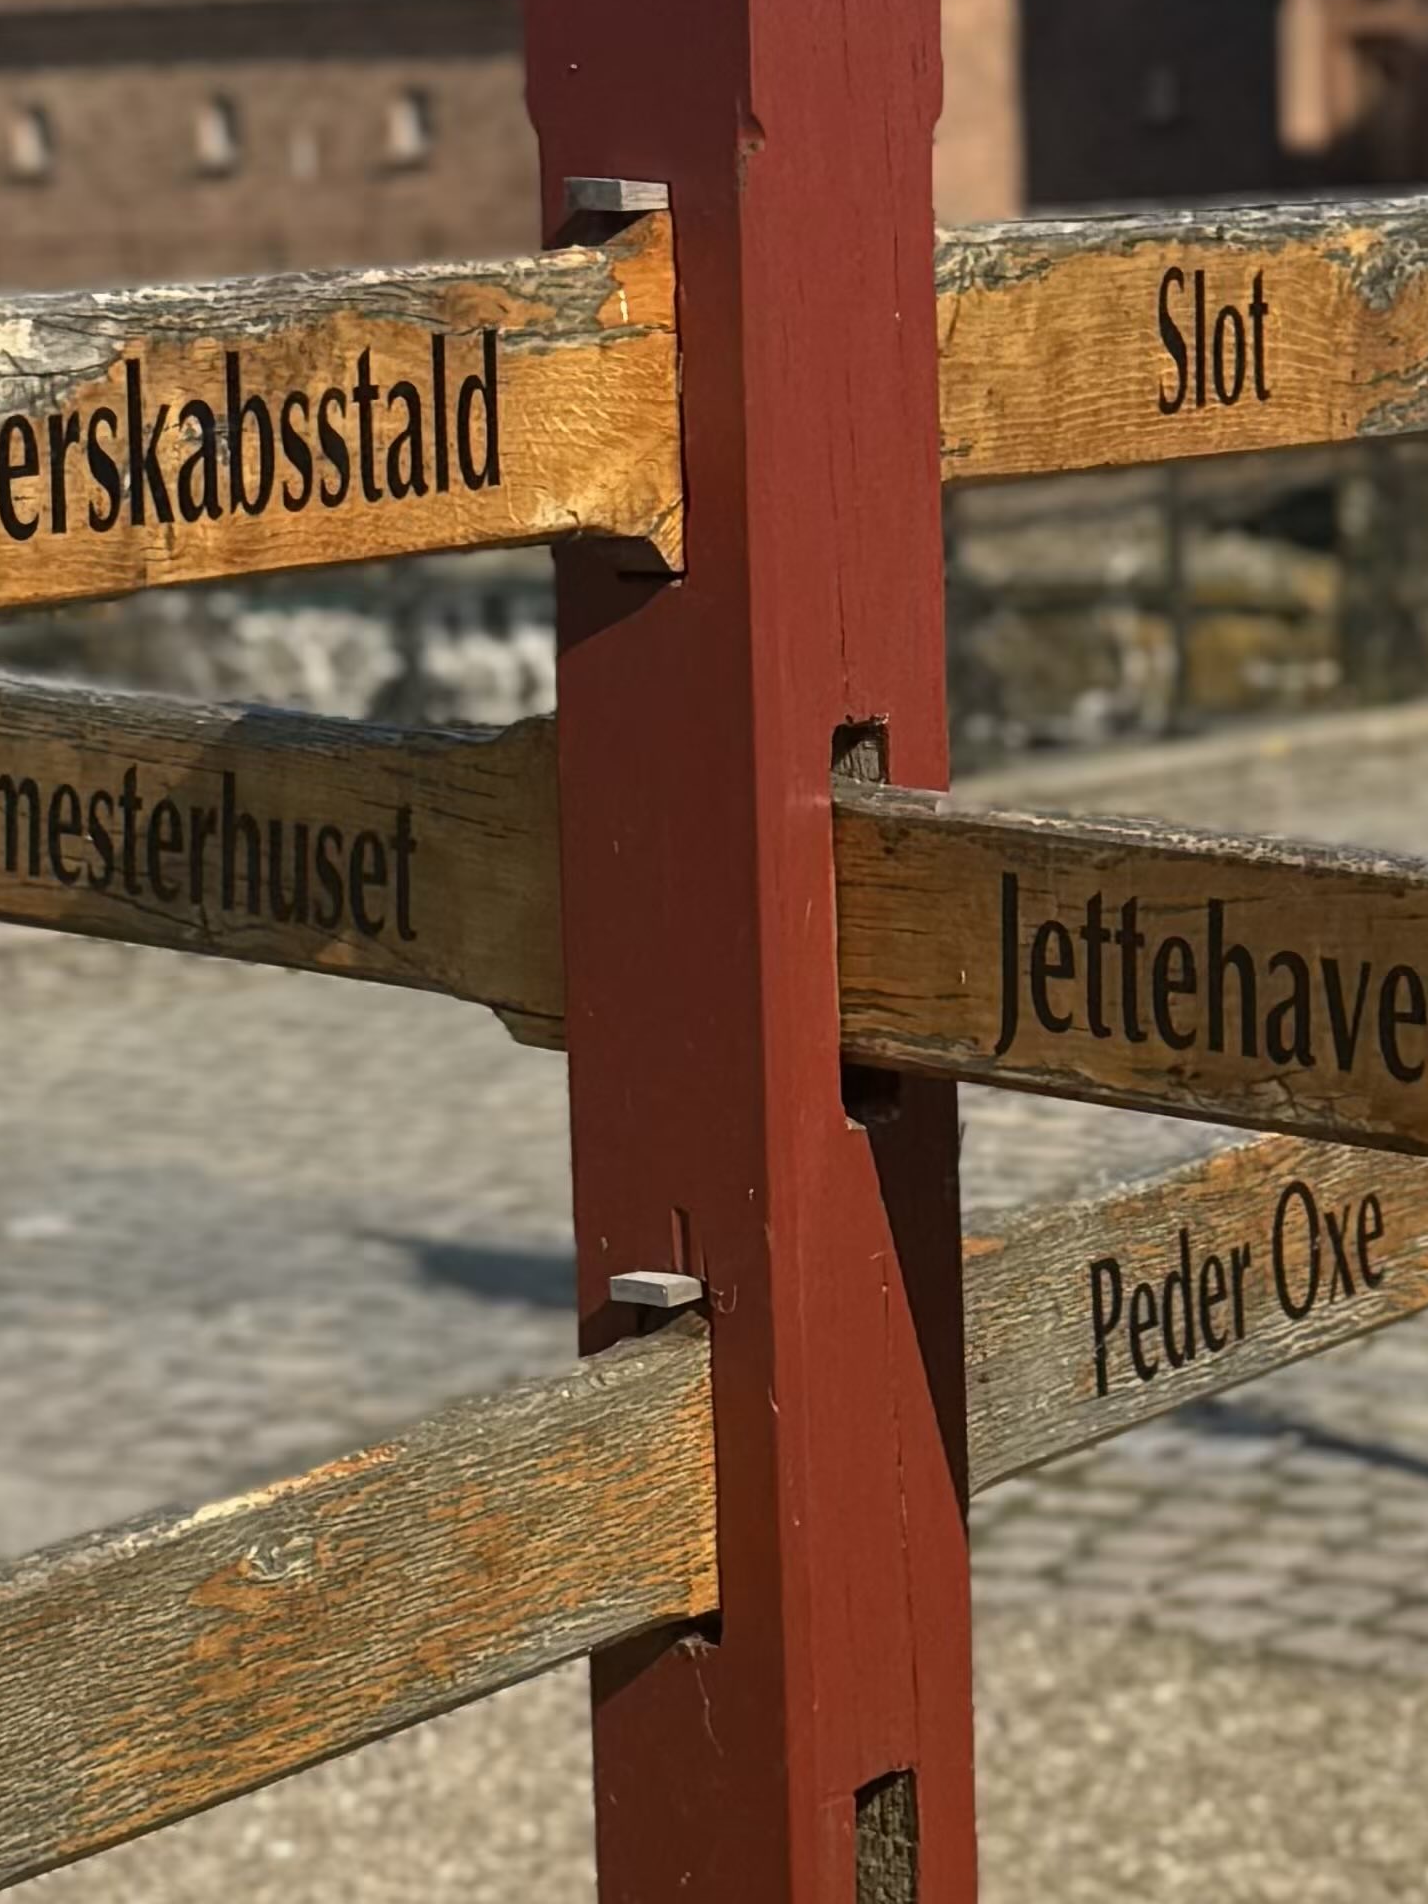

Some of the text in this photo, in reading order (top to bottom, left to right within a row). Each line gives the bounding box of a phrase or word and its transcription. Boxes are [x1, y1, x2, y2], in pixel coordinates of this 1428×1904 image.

[1157, 265, 1272, 415] Slot
[1089, 1180, 1385, 1398] Peder Oxe
